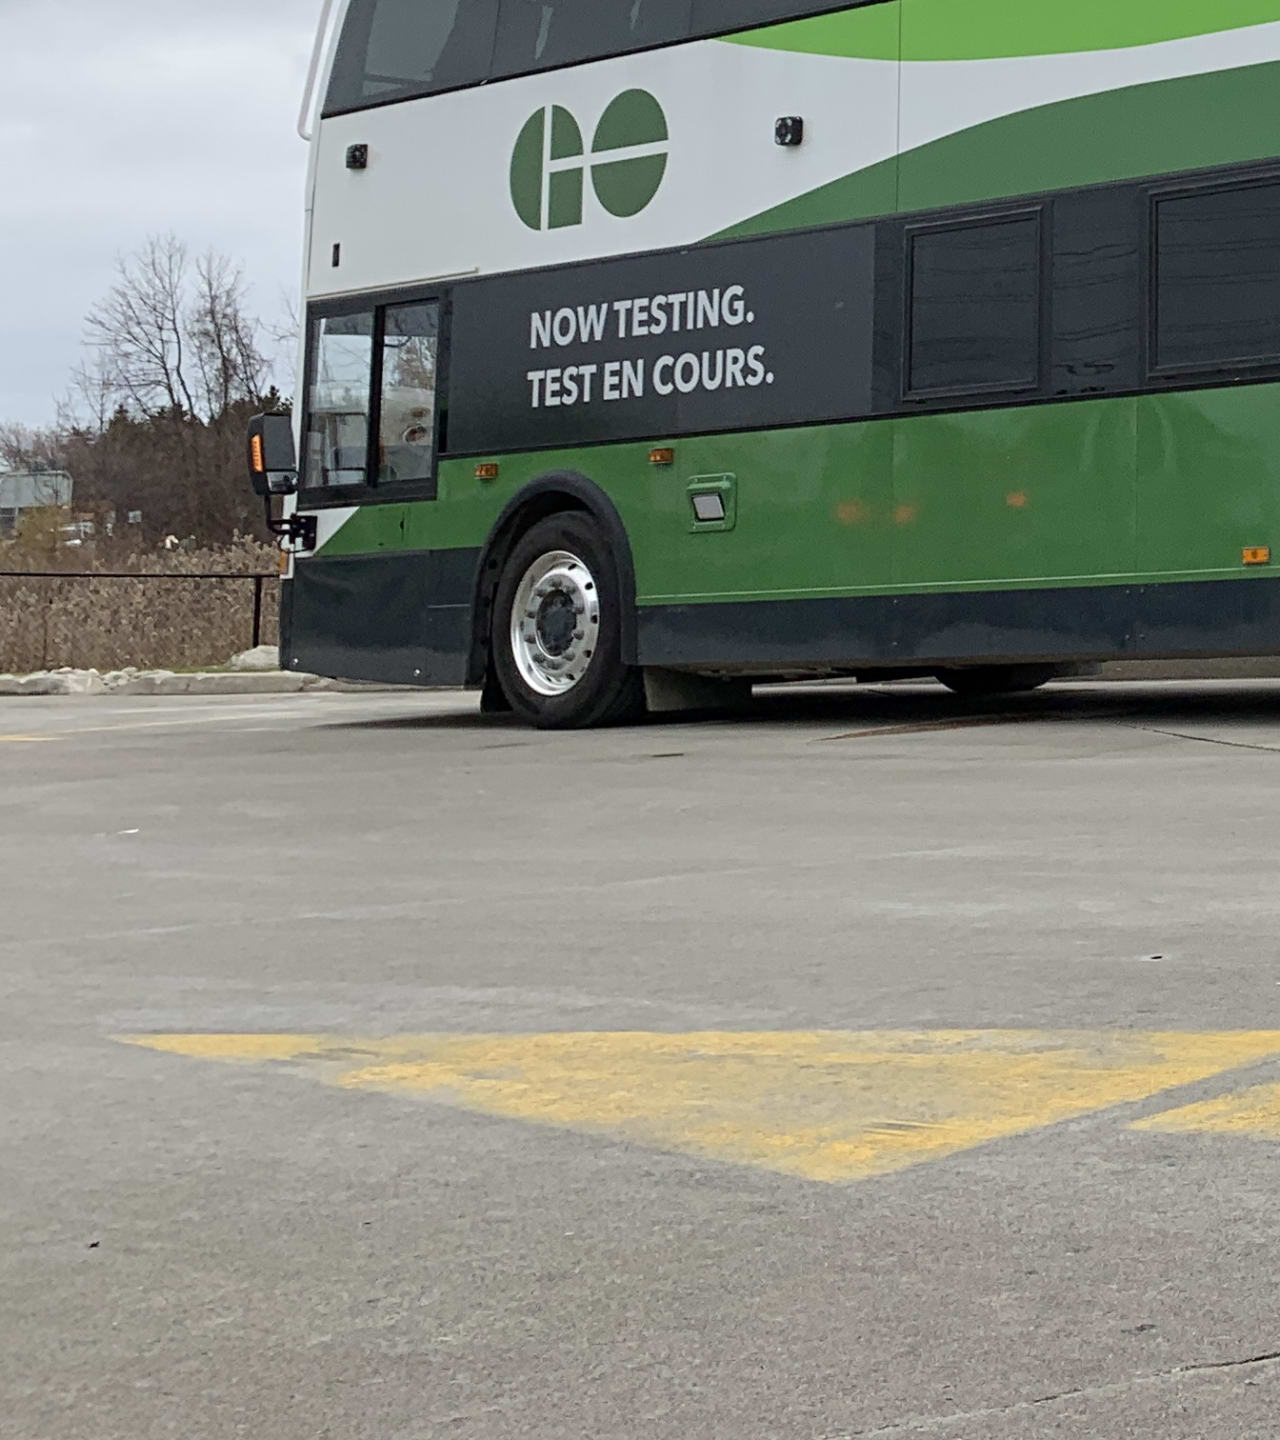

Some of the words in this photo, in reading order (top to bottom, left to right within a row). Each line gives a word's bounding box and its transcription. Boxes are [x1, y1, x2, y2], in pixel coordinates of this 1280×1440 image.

[509, 88, 670, 232] GO
[530, 303, 609, 349] NOW
[613, 285, 755, 338] TESTING.
[527, 362, 597, 408] TEST
[603, 359, 644, 401] EN
[652, 346, 774, 395] COURS.
